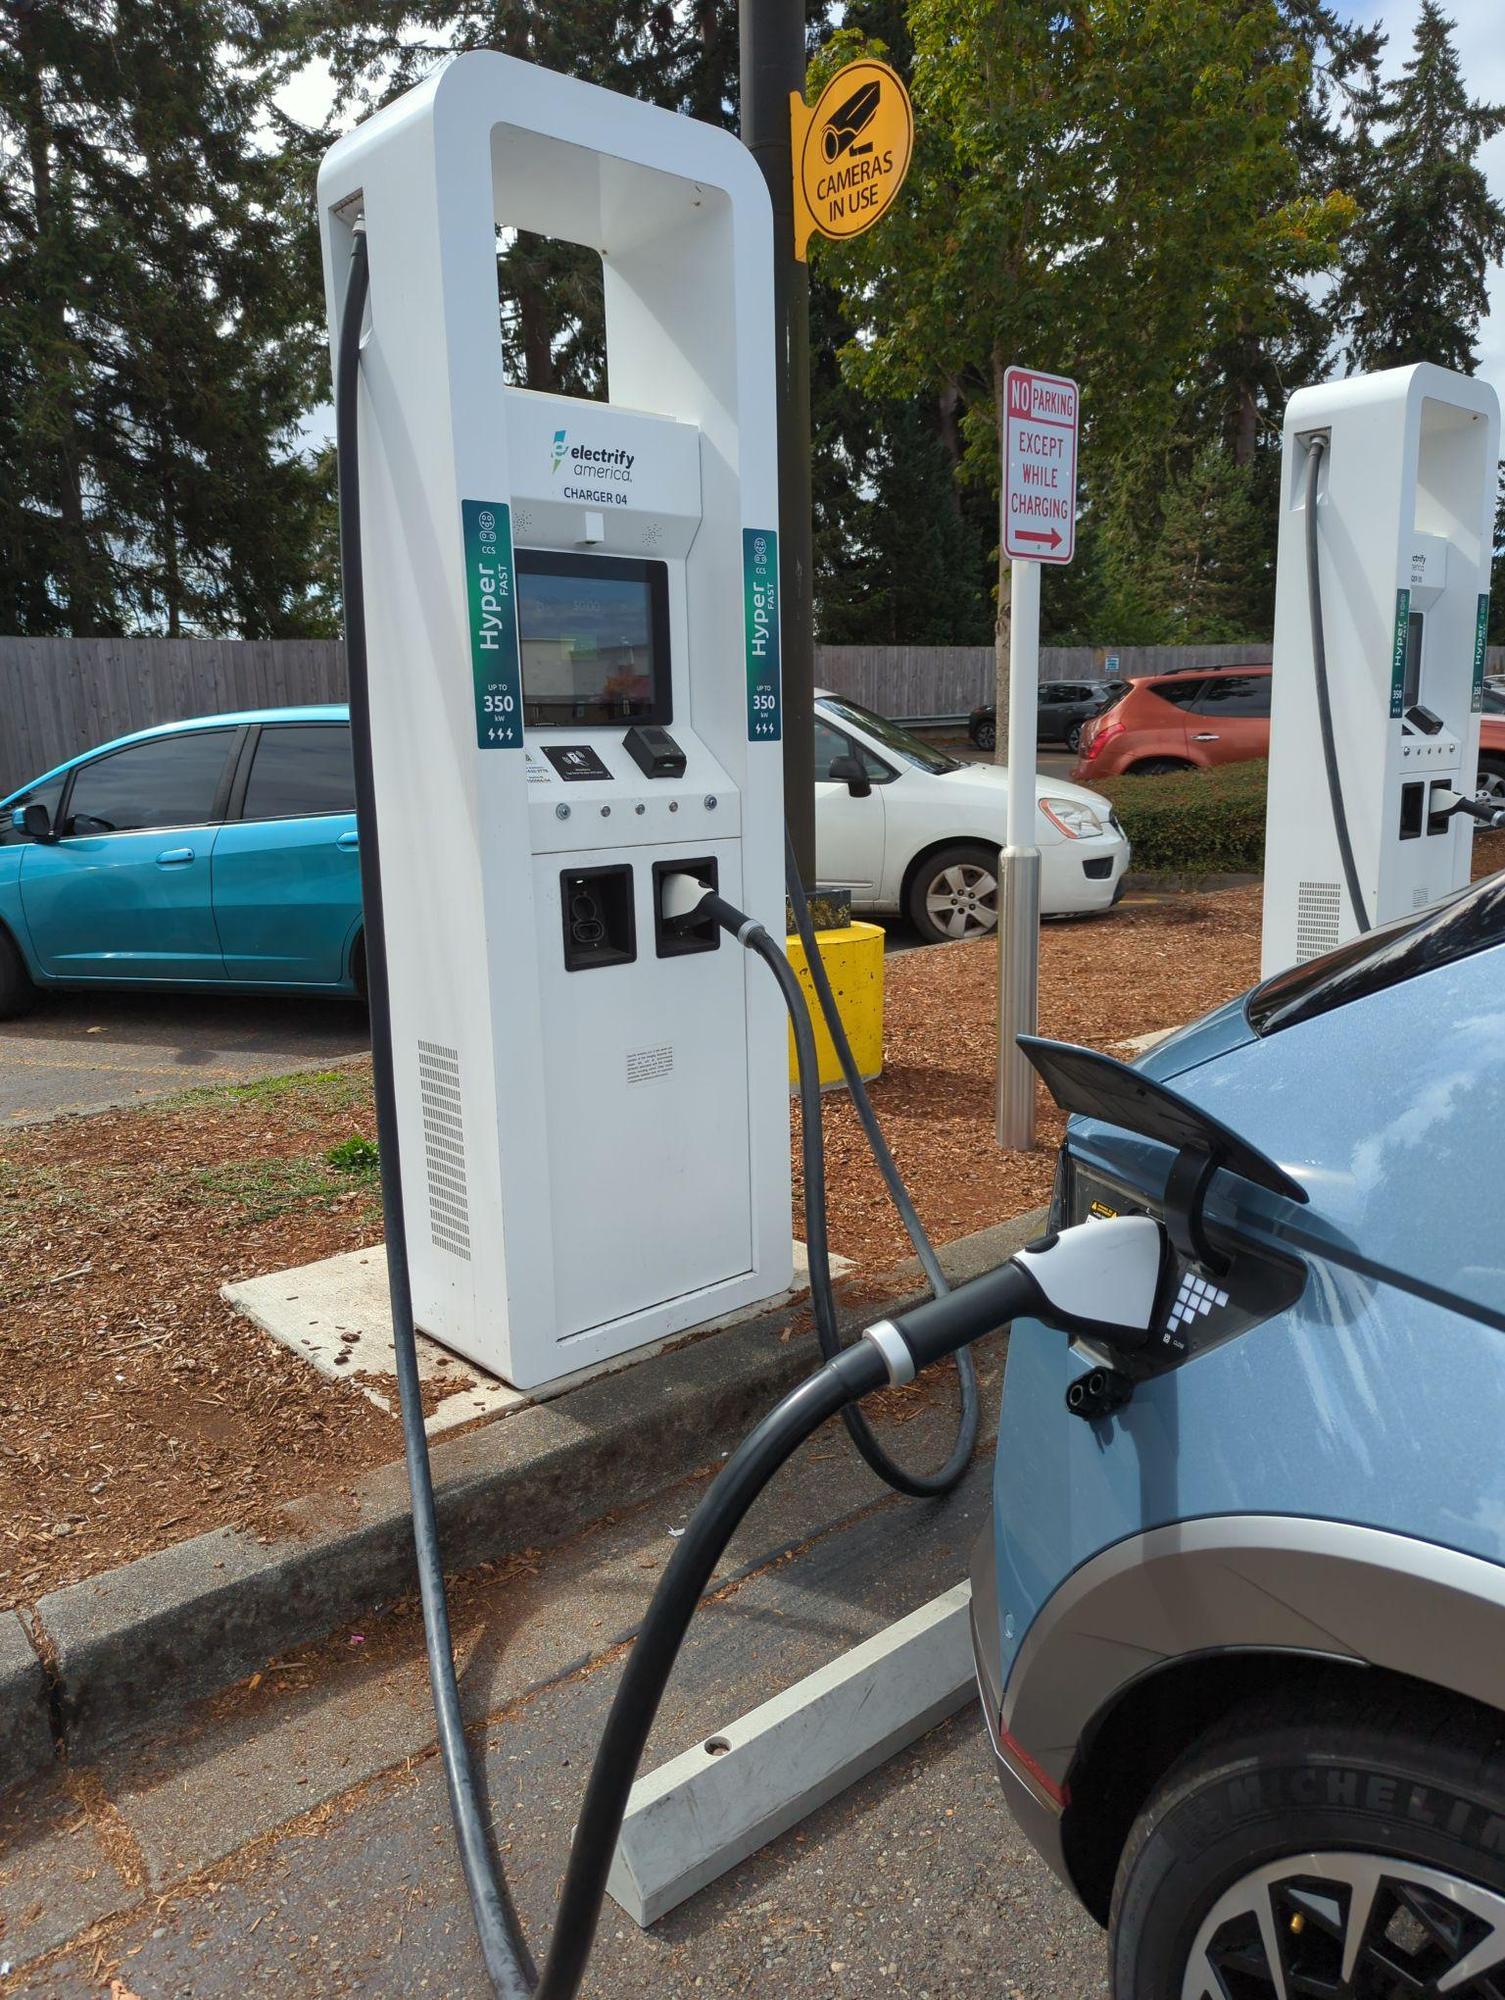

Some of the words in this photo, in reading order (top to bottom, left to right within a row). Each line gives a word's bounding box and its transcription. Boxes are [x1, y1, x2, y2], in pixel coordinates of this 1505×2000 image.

[817, 150, 893, 201] CAMERAS
[829, 200, 844, 222] IN
[849, 184, 879, 214] USE
[1012, 379, 1028, 412] NO
[1032, 388, 1073, 417] PARKING
[571, 444, 635, 469] electrify
[1019, 431, 1064, 459] EXCEPT
[1022, 463, 1058, 489] WHILE
[563, 487, 613, 503] CHARGER
[615, 493, 628, 505] 04
[1011, 492, 1068, 520] CHARGING
[481, 546, 496, 554] CCS
[498, 563, 509, 596] FAST
[479, 563, 503, 649] Hyper
[767, 582, 775, 610] FAST
[752, 582, 769, 656] Hyper
[1395, 622, 1403, 667] Hyper
[483, 695, 514, 712] 350
[753, 695, 776, 710] 350
